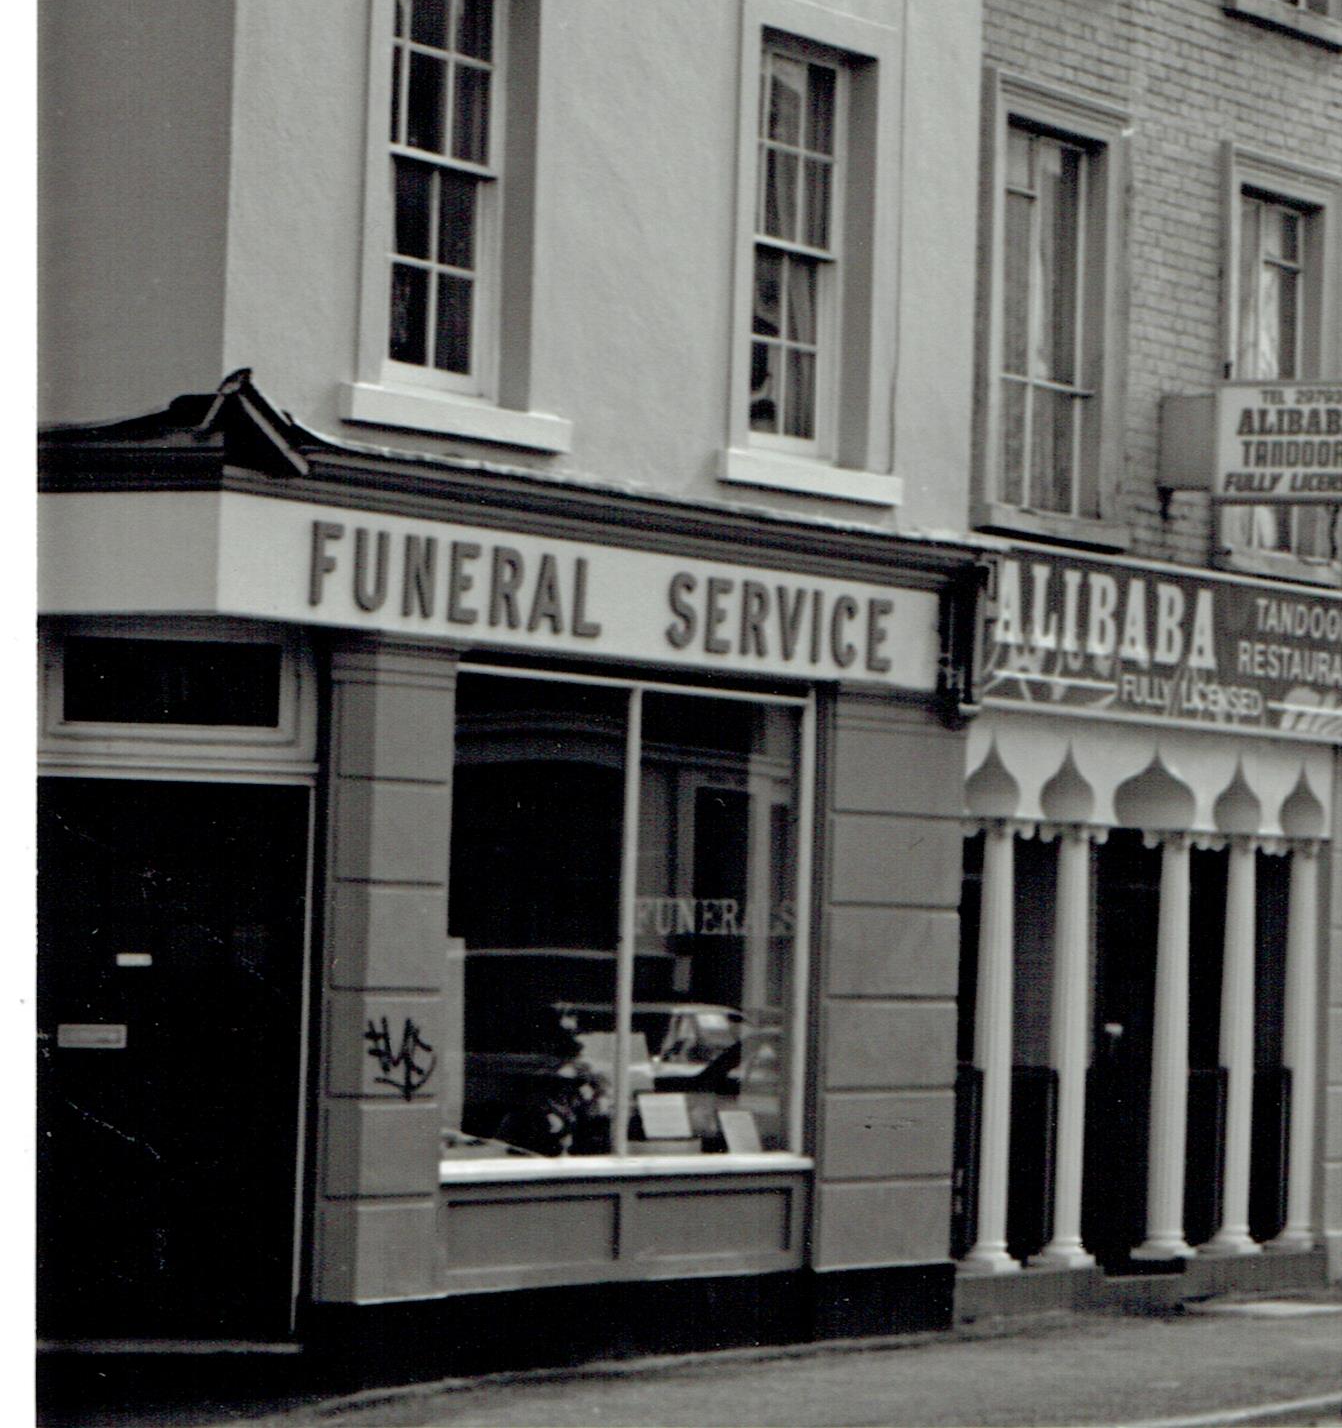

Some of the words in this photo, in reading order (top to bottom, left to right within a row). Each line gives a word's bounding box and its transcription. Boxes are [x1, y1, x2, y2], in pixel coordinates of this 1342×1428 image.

[1262, 389, 1285, 405] TEL
[1224, 473, 1282, 492] FULLY
[309, 520, 601, 639] FUNERAL
[665, 571, 896, 673] SERVICE
[995, 559, 1217, 670] ALIBABA
[1121, 674, 1170, 708] FULLY
[1181, 678, 1263, 716] LICENSED
[635, 897, 797, 936] FUNERS
